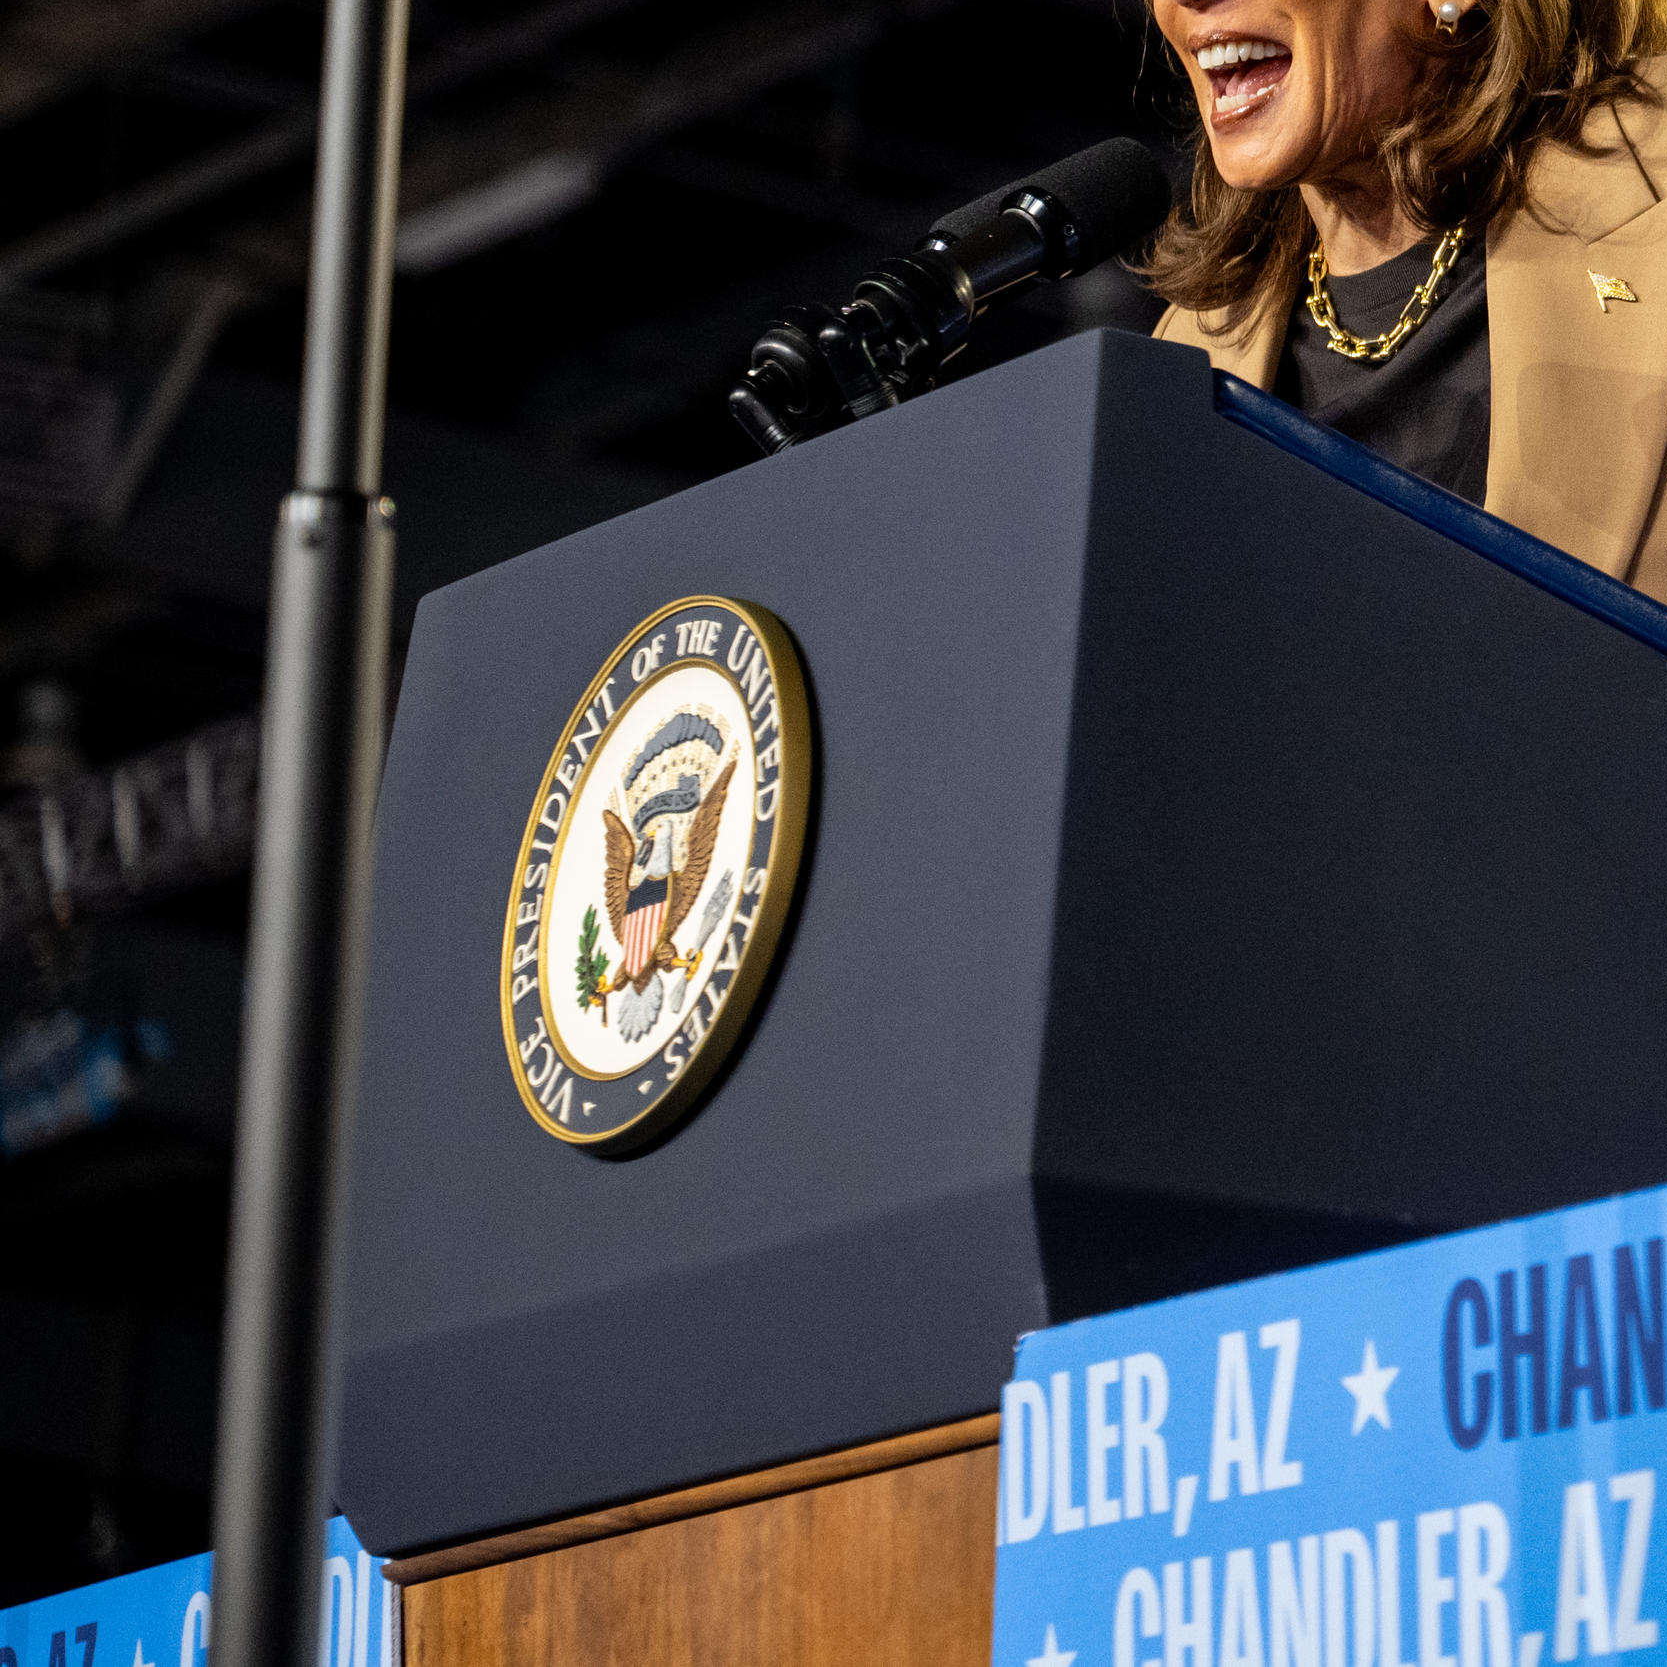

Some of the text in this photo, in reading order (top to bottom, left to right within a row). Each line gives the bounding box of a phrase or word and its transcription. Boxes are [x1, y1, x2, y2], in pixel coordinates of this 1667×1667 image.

[631, 634, 667, 683] OF
[675, 620, 723, 658] THE
[726, 624, 780, 822] UNITED
[512, 677, 617, 1006] PRESIDENT
[519, 1017, 574, 1125] VICE
[664, 867, 767, 1082] STATES
[996, 1318, 1304, 1549] DLER, AZ
[1554, 1469, 1660, 1665] AZ
